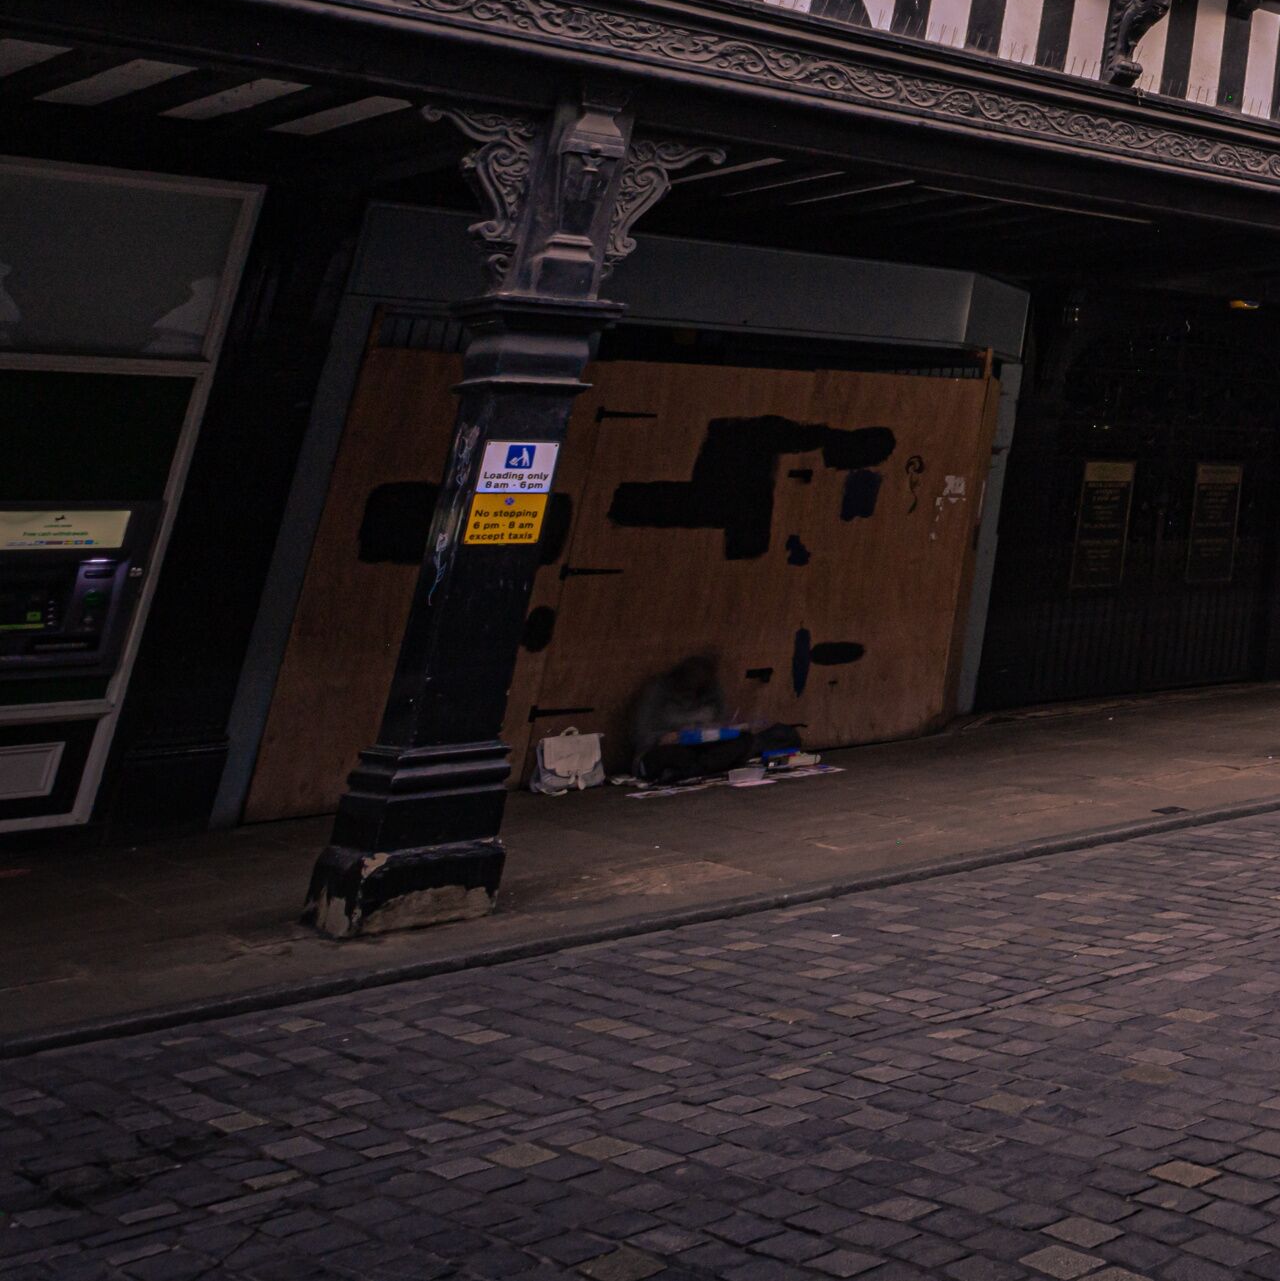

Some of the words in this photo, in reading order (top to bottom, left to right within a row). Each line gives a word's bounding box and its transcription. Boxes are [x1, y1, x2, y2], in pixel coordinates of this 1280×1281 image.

[484, 472, 524, 480] Loading
[527, 472, 549, 480] only
[494, 510, 537, 518] stopping
[469, 533, 505, 541] except
[508, 532, 533, 540] taxis
